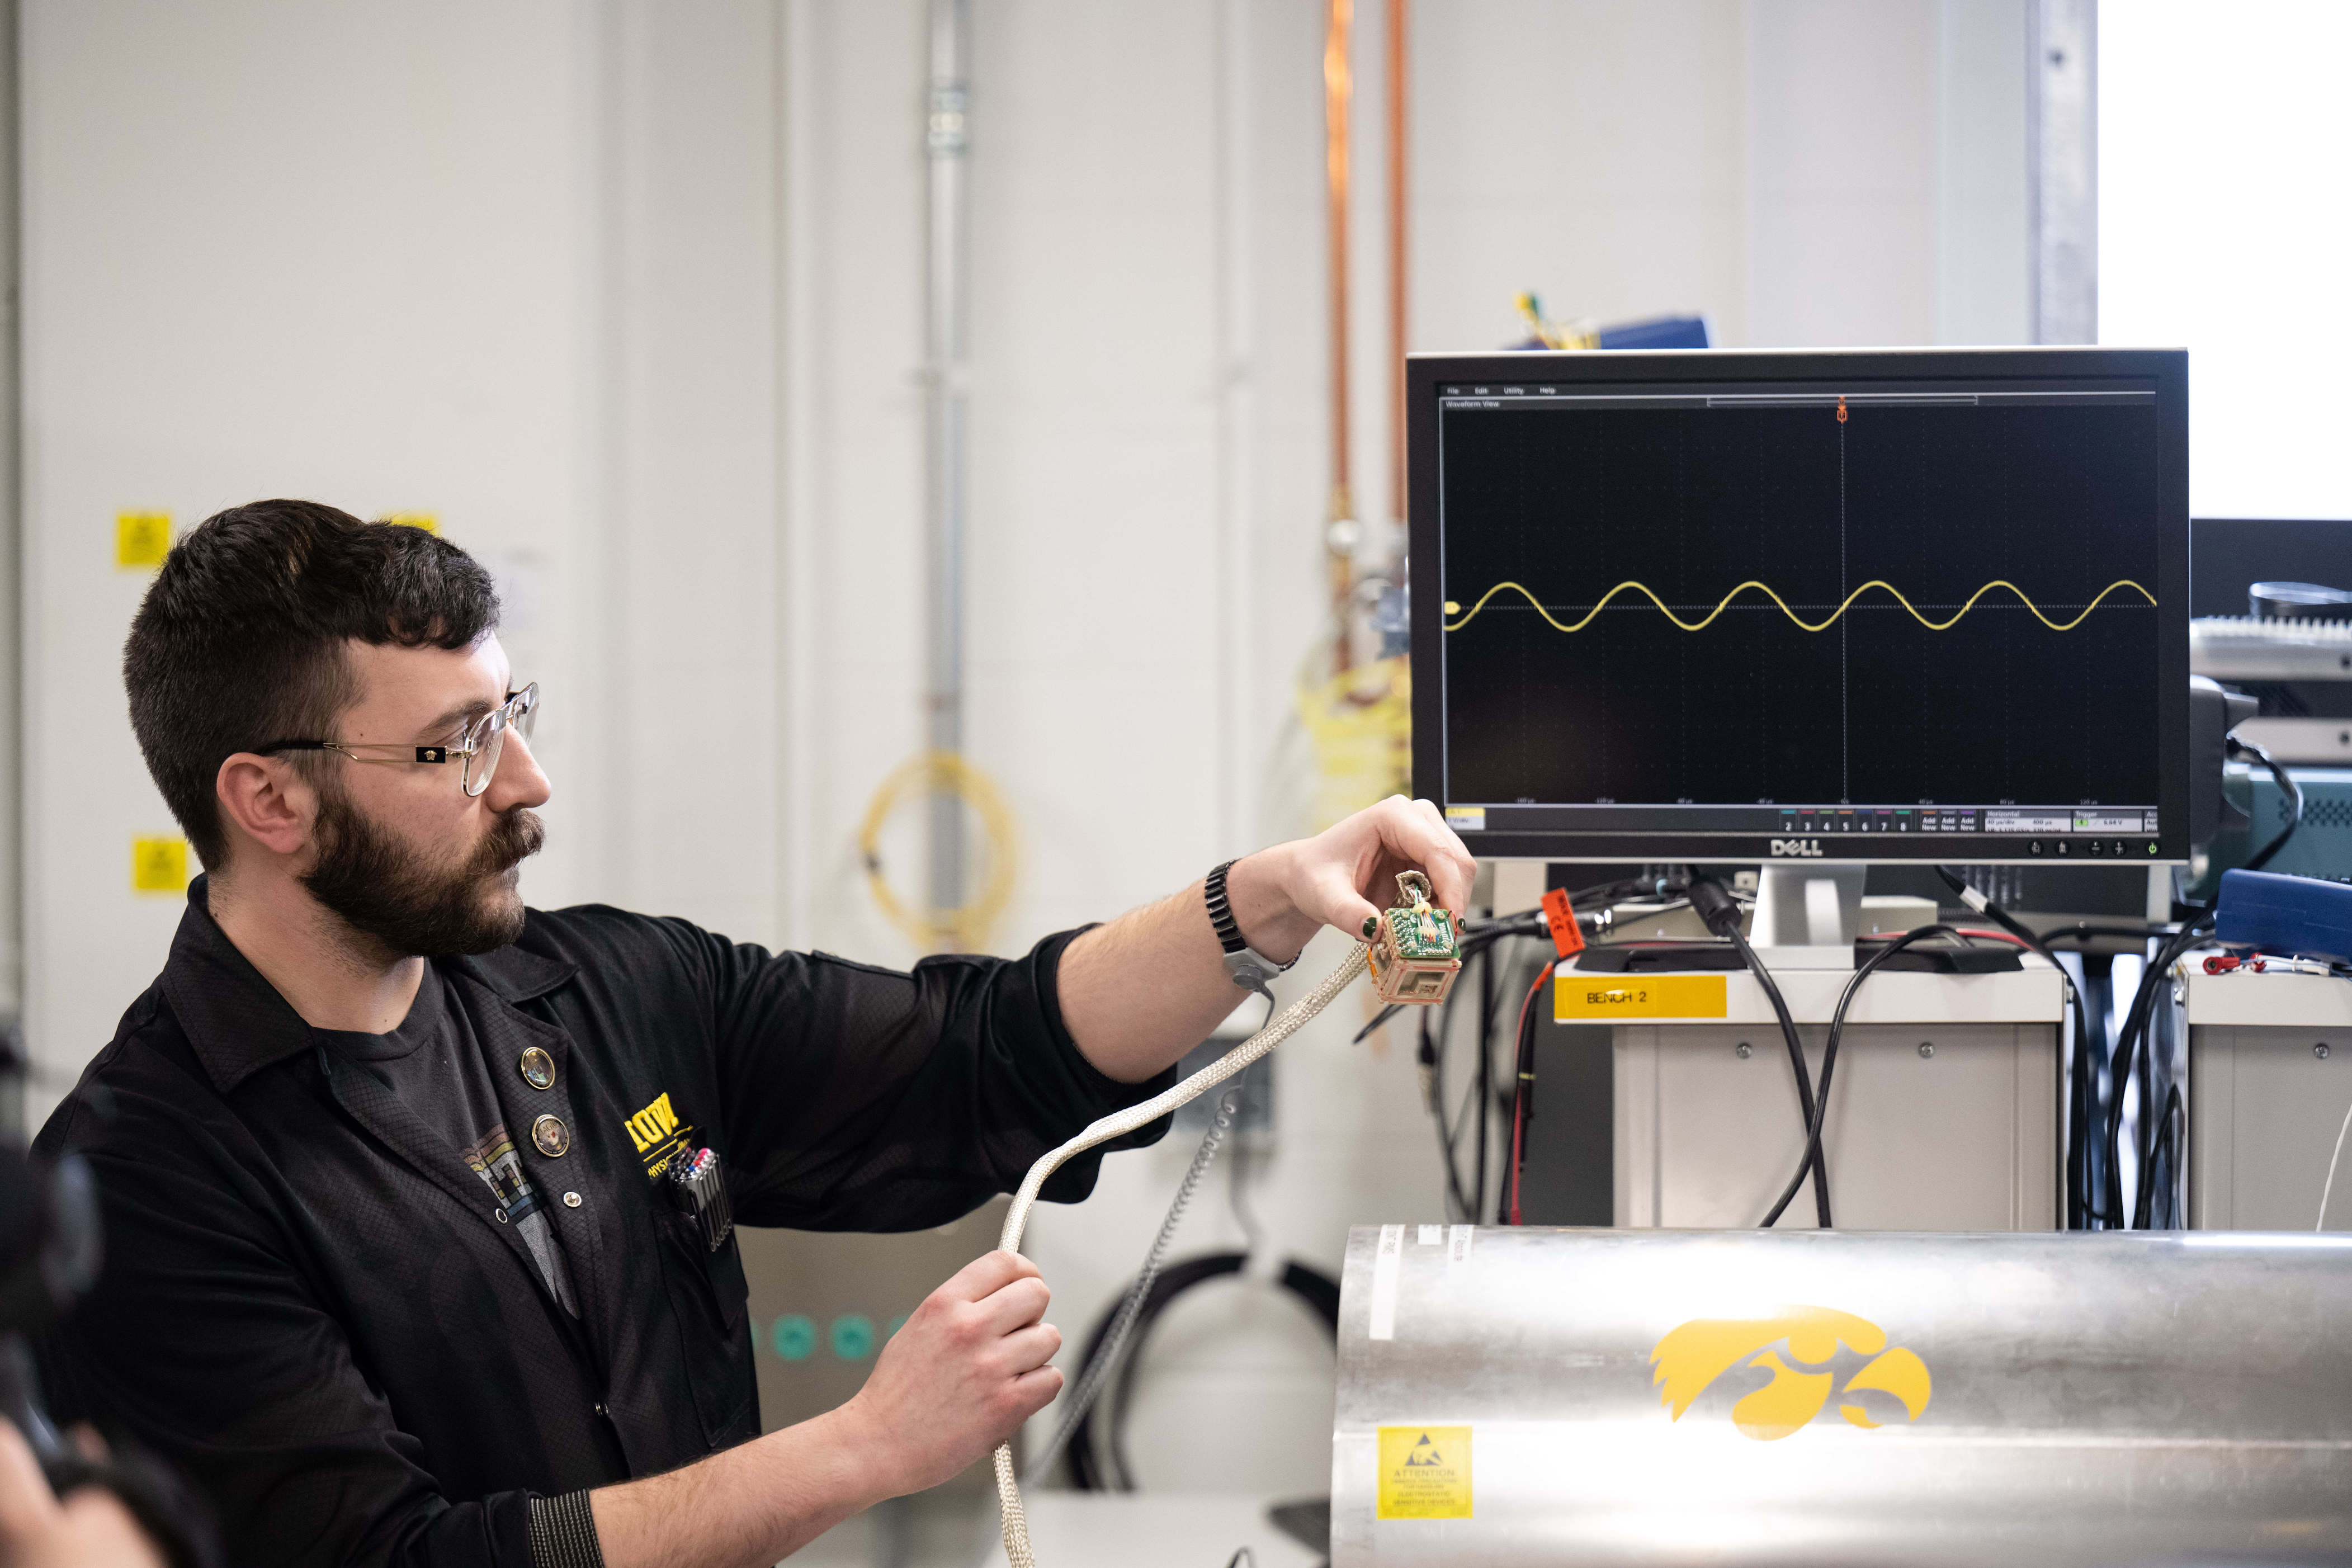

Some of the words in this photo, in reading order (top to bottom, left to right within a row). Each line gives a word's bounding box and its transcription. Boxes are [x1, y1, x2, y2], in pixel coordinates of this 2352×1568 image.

[1504, 386, 1524, 395] Utility
[1539, 386, 1556, 395] Help
[1785, 821, 1792, 832] 2
[1805, 821, 1812, 832] 3
[1823, 821, 1830, 832] 4
[1843, 821, 1850, 832] 5
[1862, 821, 1869, 832] 6
[1881, 821, 1888, 832] 7
[1900, 821, 1907, 832] 8
[1770, 839, 1824, 857] DELL
[1586, 991, 1632, 1004] BENCH
[1638, 991, 1647, 1003] 2
